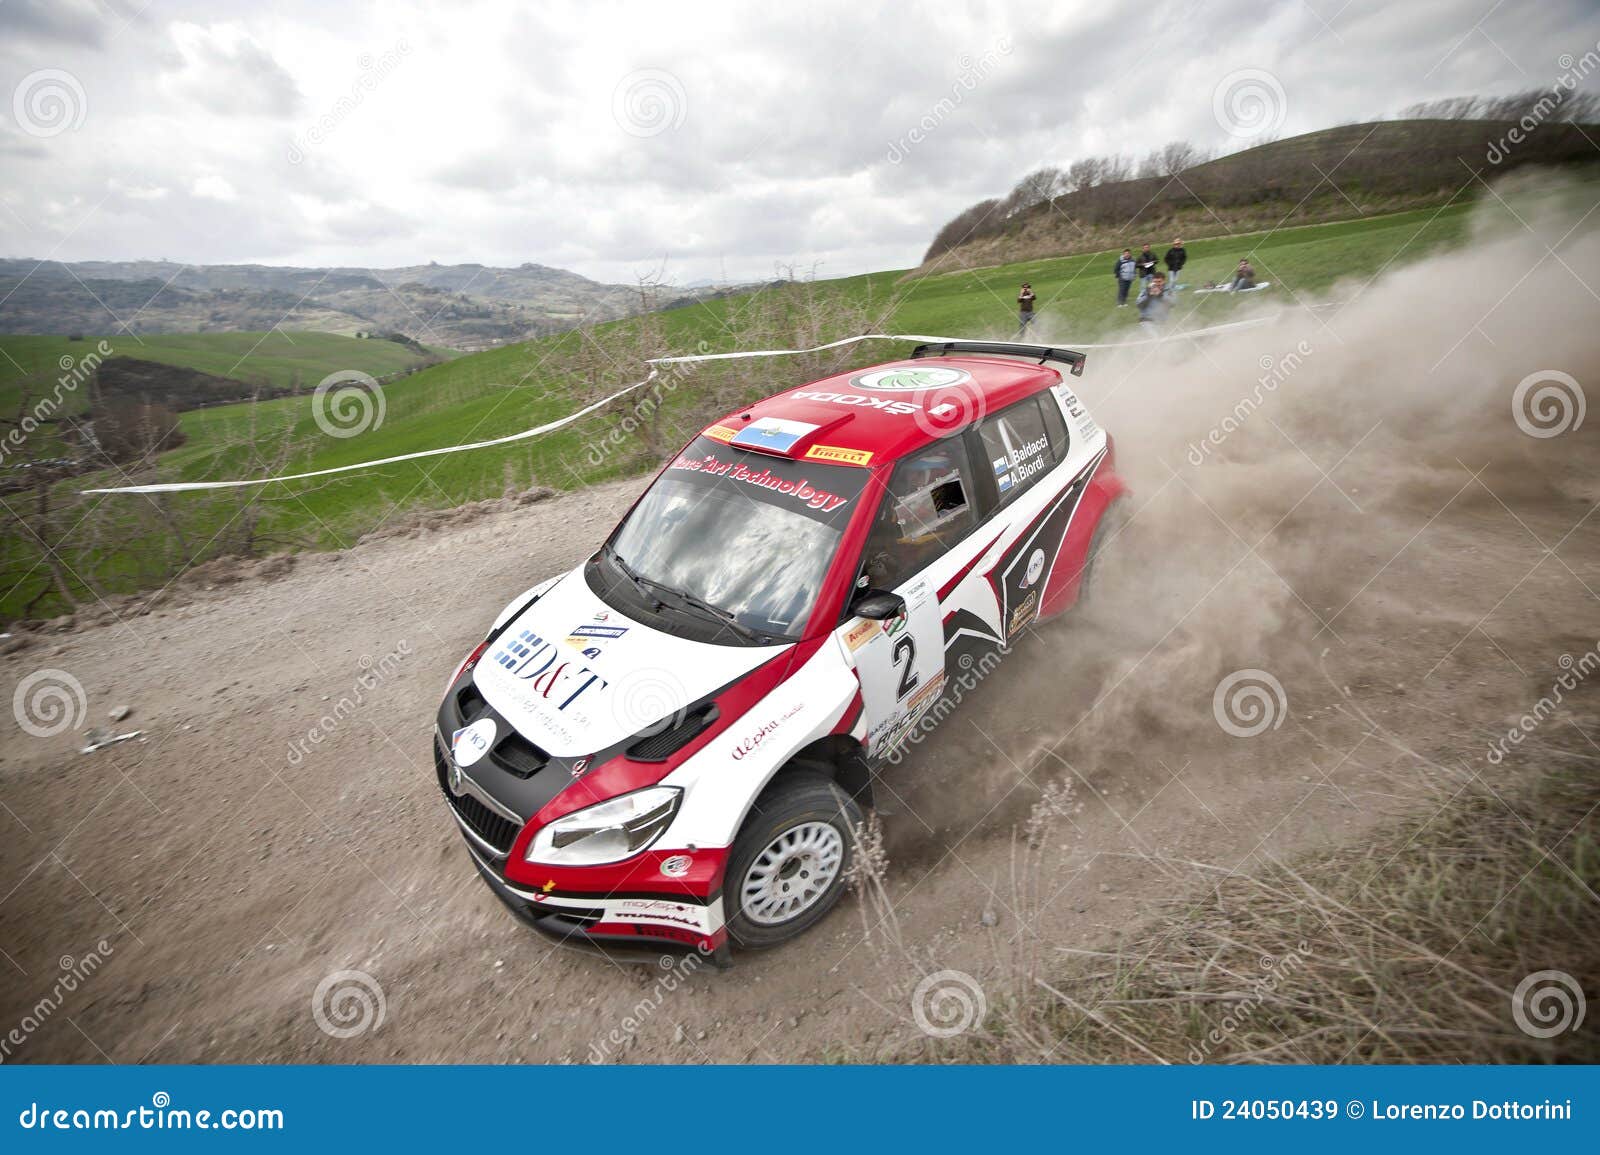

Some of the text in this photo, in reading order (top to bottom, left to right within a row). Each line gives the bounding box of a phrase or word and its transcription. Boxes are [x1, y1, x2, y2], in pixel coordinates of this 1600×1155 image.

[812, 447, 866, 461] PIRELLI
[729, 463, 848, 513] Technology
[891, 632, 920, 704] 2
